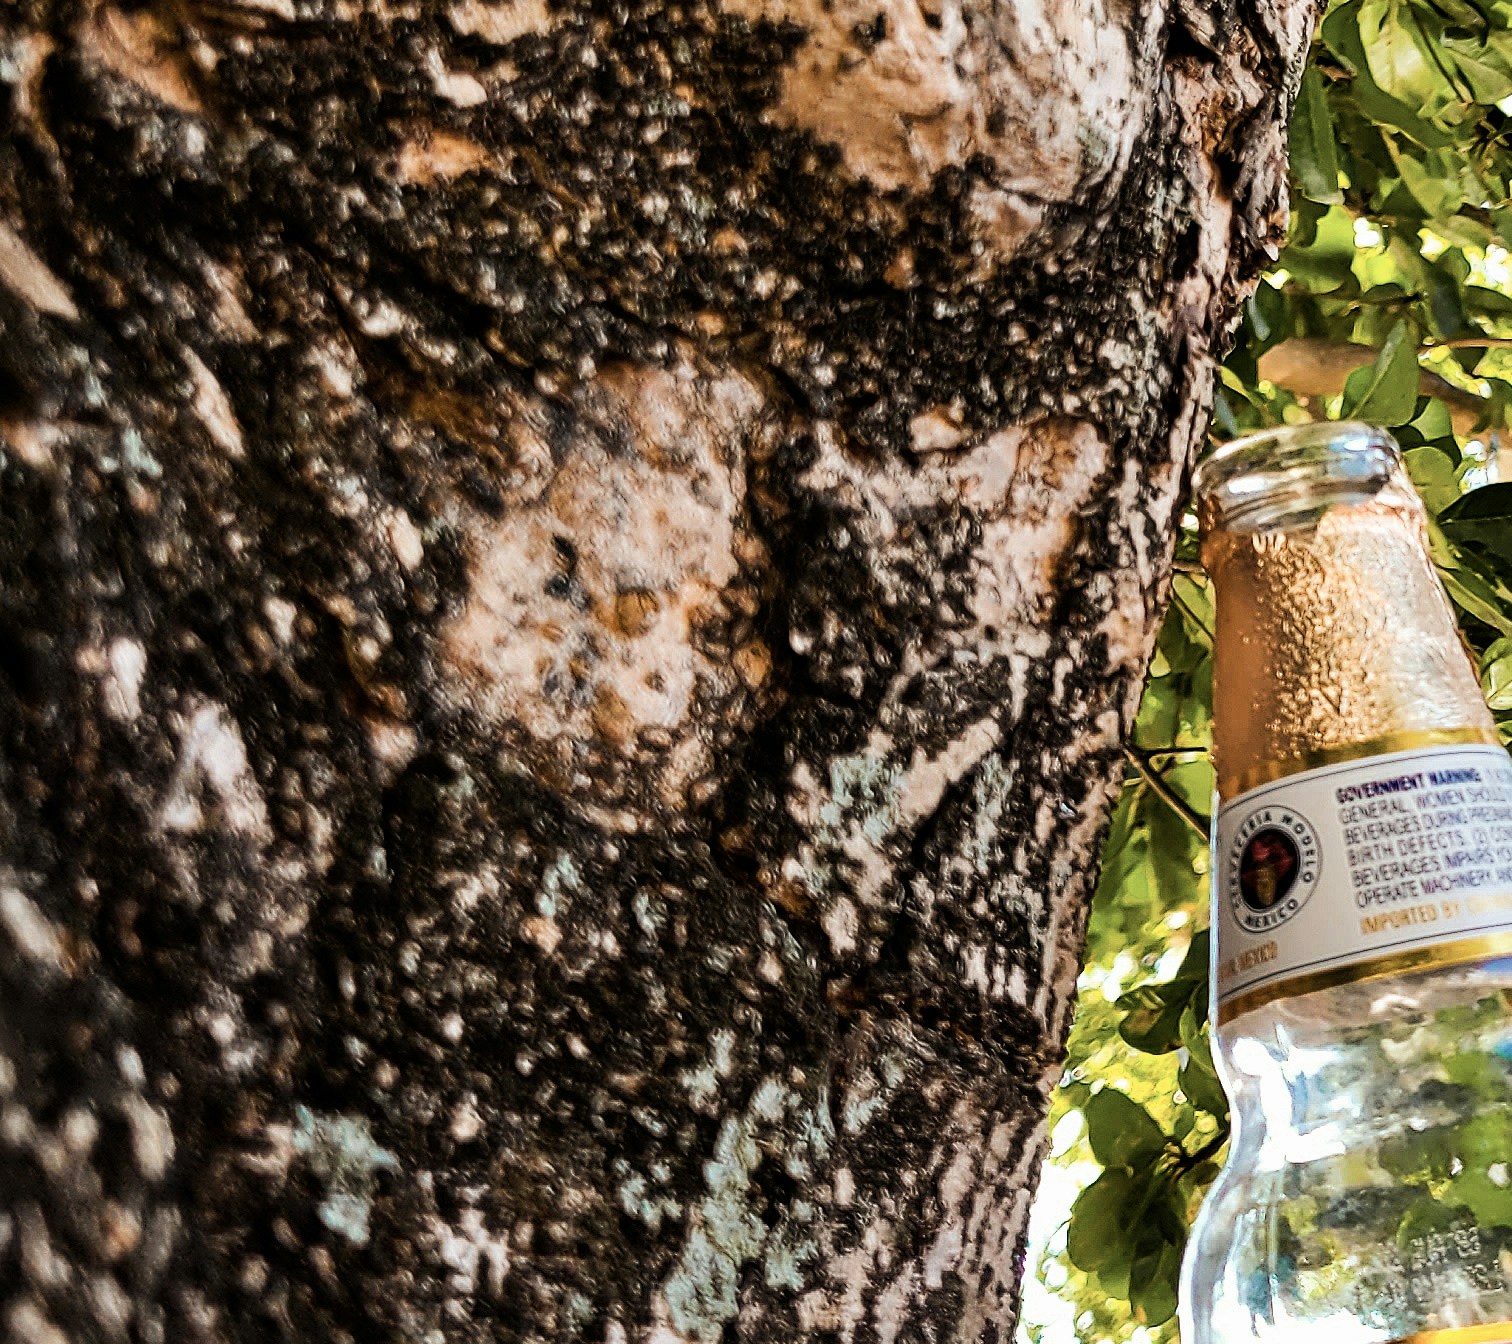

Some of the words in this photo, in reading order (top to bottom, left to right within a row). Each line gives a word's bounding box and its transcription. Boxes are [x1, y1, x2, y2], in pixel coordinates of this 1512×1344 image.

[1336, 773, 1425, 803] GOVERNMENT
[1345, 814, 1421, 845] BEVERAGES
[1281, 812, 1317, 883] MODELO
[1346, 843, 1396, 867] BIRTH
[1351, 854, 1442, 888] BEVERAGES
[1356, 879, 1420, 908] OPERATE
[1244, 898, 1298, 929] MEXICO
[1360, 904, 1438, 936] IMPORTED
